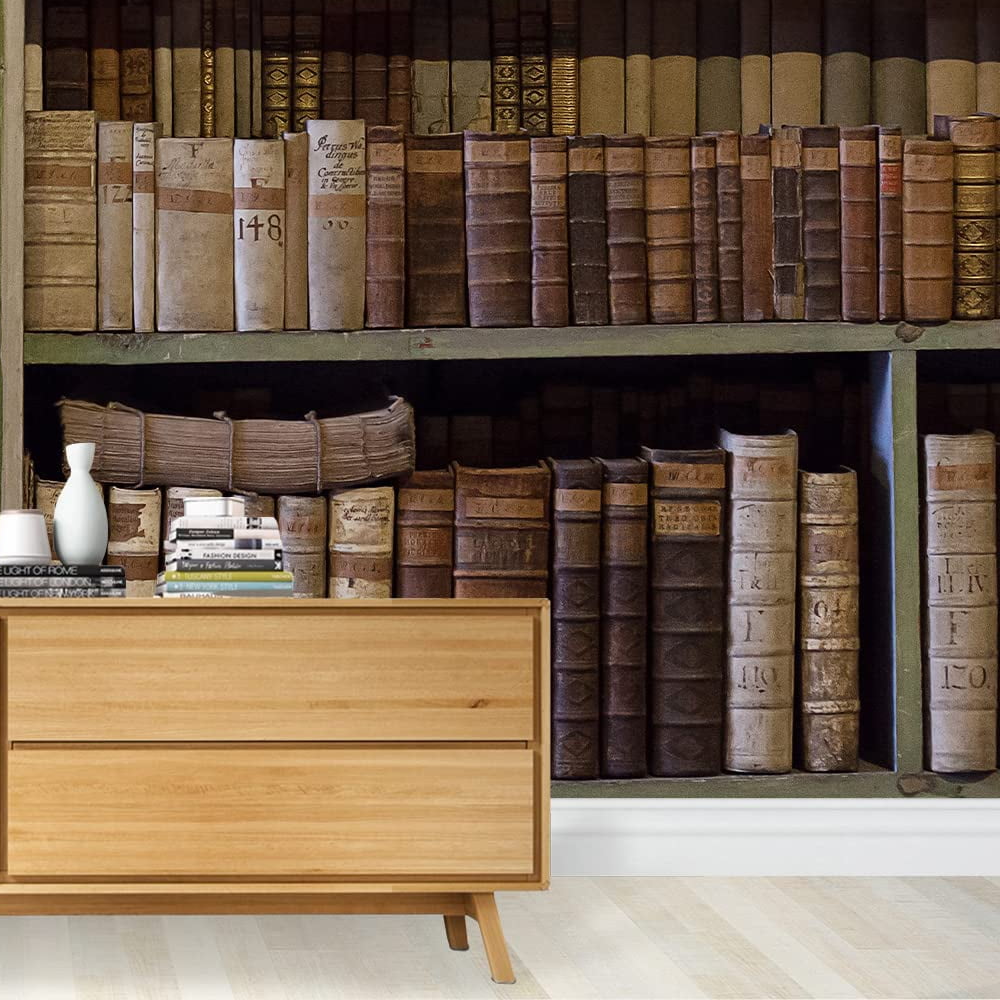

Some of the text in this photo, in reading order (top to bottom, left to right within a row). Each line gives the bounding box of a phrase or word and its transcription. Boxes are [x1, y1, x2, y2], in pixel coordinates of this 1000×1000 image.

[3, 566, 31, 576] LIGHT
[32, 566, 47, 576] OF
[48, 566, 78, 576] ROME
[4, 577, 31, 587] LIGHT
[33, 577, 48, 587] OF
[49, 577, 92, 587] LONDON
[2, 588, 29, 598] LIGHT
[31, 588, 44, 598] OF
